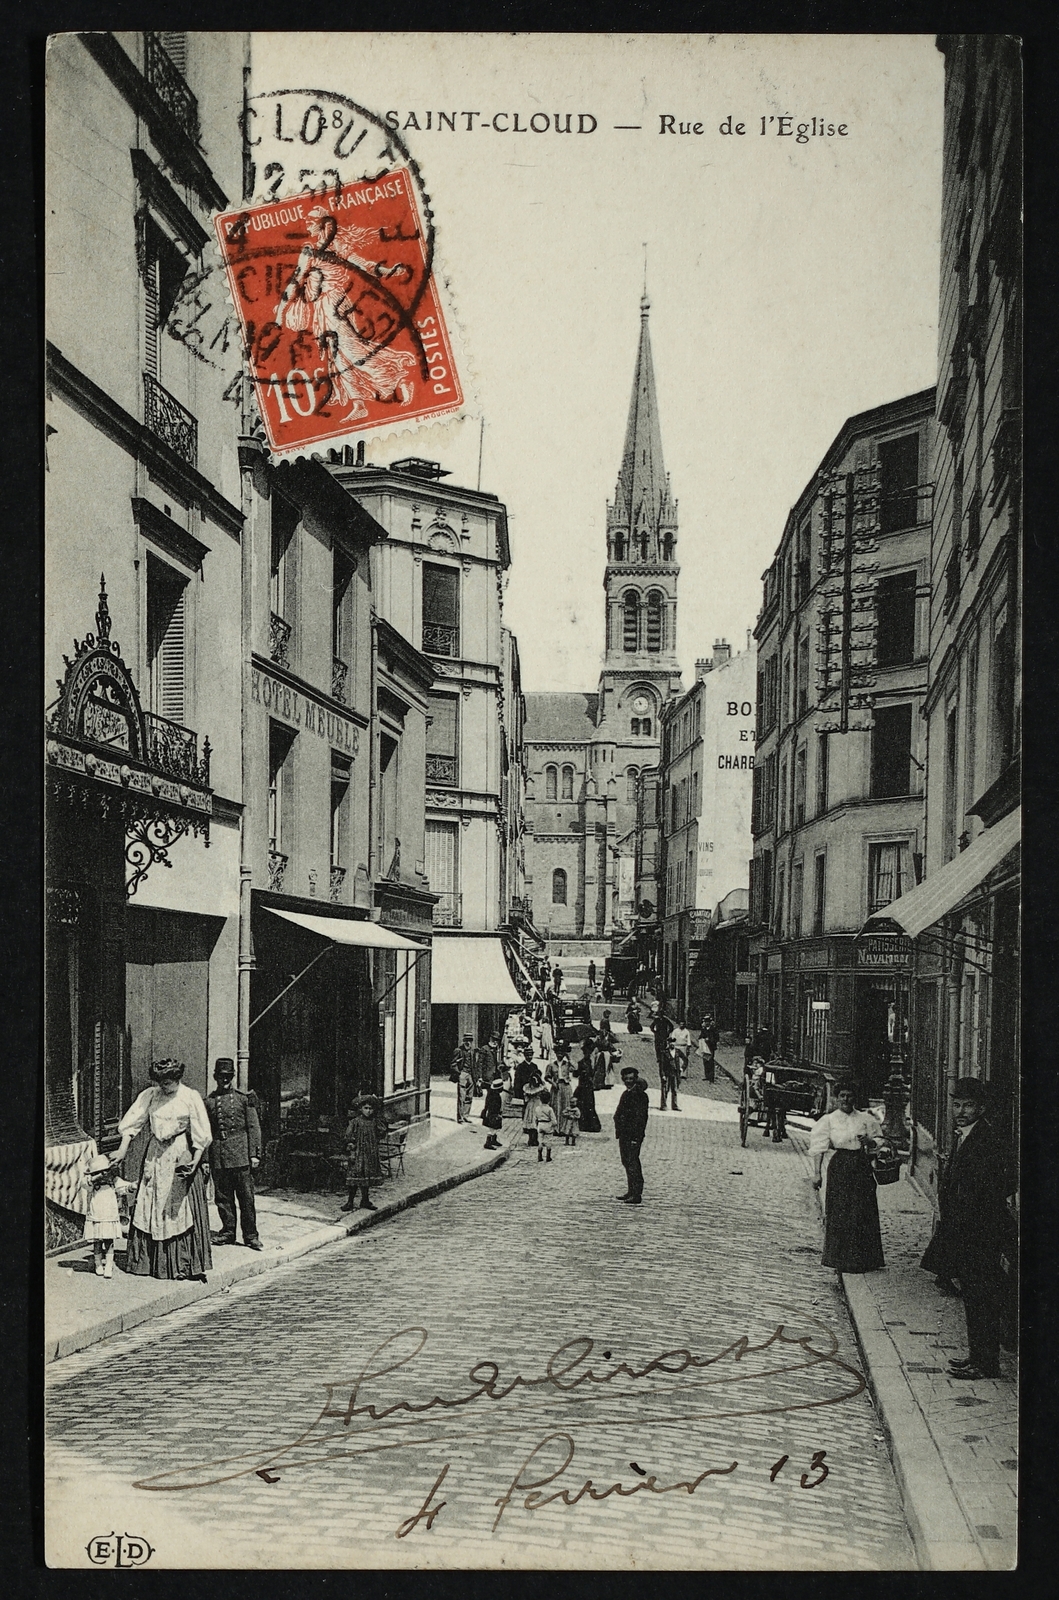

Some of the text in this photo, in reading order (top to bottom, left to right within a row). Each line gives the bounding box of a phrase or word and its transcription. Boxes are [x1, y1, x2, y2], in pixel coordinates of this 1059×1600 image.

[224, 178, 404, 237] RPUBLIQUE FRANÇAISE
[417, 316, 451, 395] POSTES
[726, 701, 757, 717] BO
[717, 754, 755, 770] CHARB
